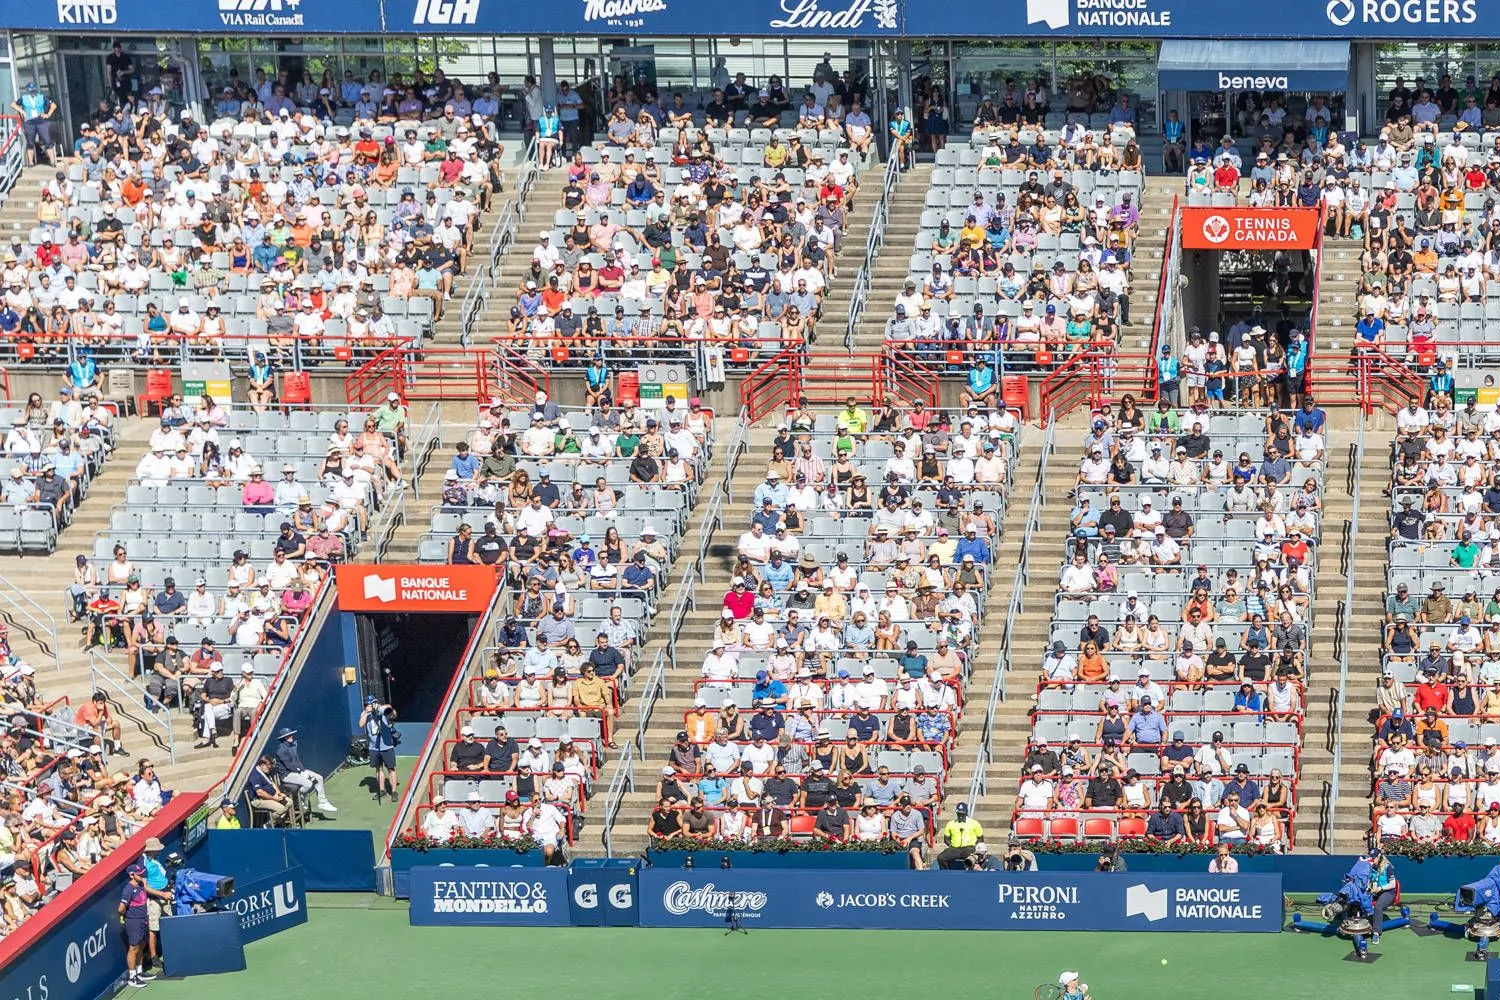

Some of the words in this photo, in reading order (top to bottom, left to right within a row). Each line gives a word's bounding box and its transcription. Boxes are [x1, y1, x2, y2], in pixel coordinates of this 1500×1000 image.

[58, 5, 117, 24] KIND
[220, 13, 243, 25] VIA
[244, 13, 266, 25] Rail
[413, 0, 480, 24] IGA
[770, 0, 871, 28] Lindt
[1078, 11, 1171, 26] NATIONALE
[1363, 0, 1477, 24] ROGERS
[1218, 72, 1288, 89] beneva
[1234, 217, 1291, 229] TENNIS
[1234, 230, 1298, 242] CANADA
[400, 577, 450, 589] BANQUE
[401, 589, 467, 601] NATIONALE
[663, 880, 767, 915] Cashmere
[837, 892, 896, 908] JACOB'S
[900, 894, 950, 908] CREEK
[998, 883, 1077, 904] PERONI
[1175, 888, 1240, 903] BANQUE
[433, 899, 547, 914] MONDELLO
[1019, 904, 1056, 912] NASTRO
[1175, 904, 1262, 919] NATIONALE
[1010, 911, 1065, 919] AZZURRO
[83, 923, 108, 964] razr
